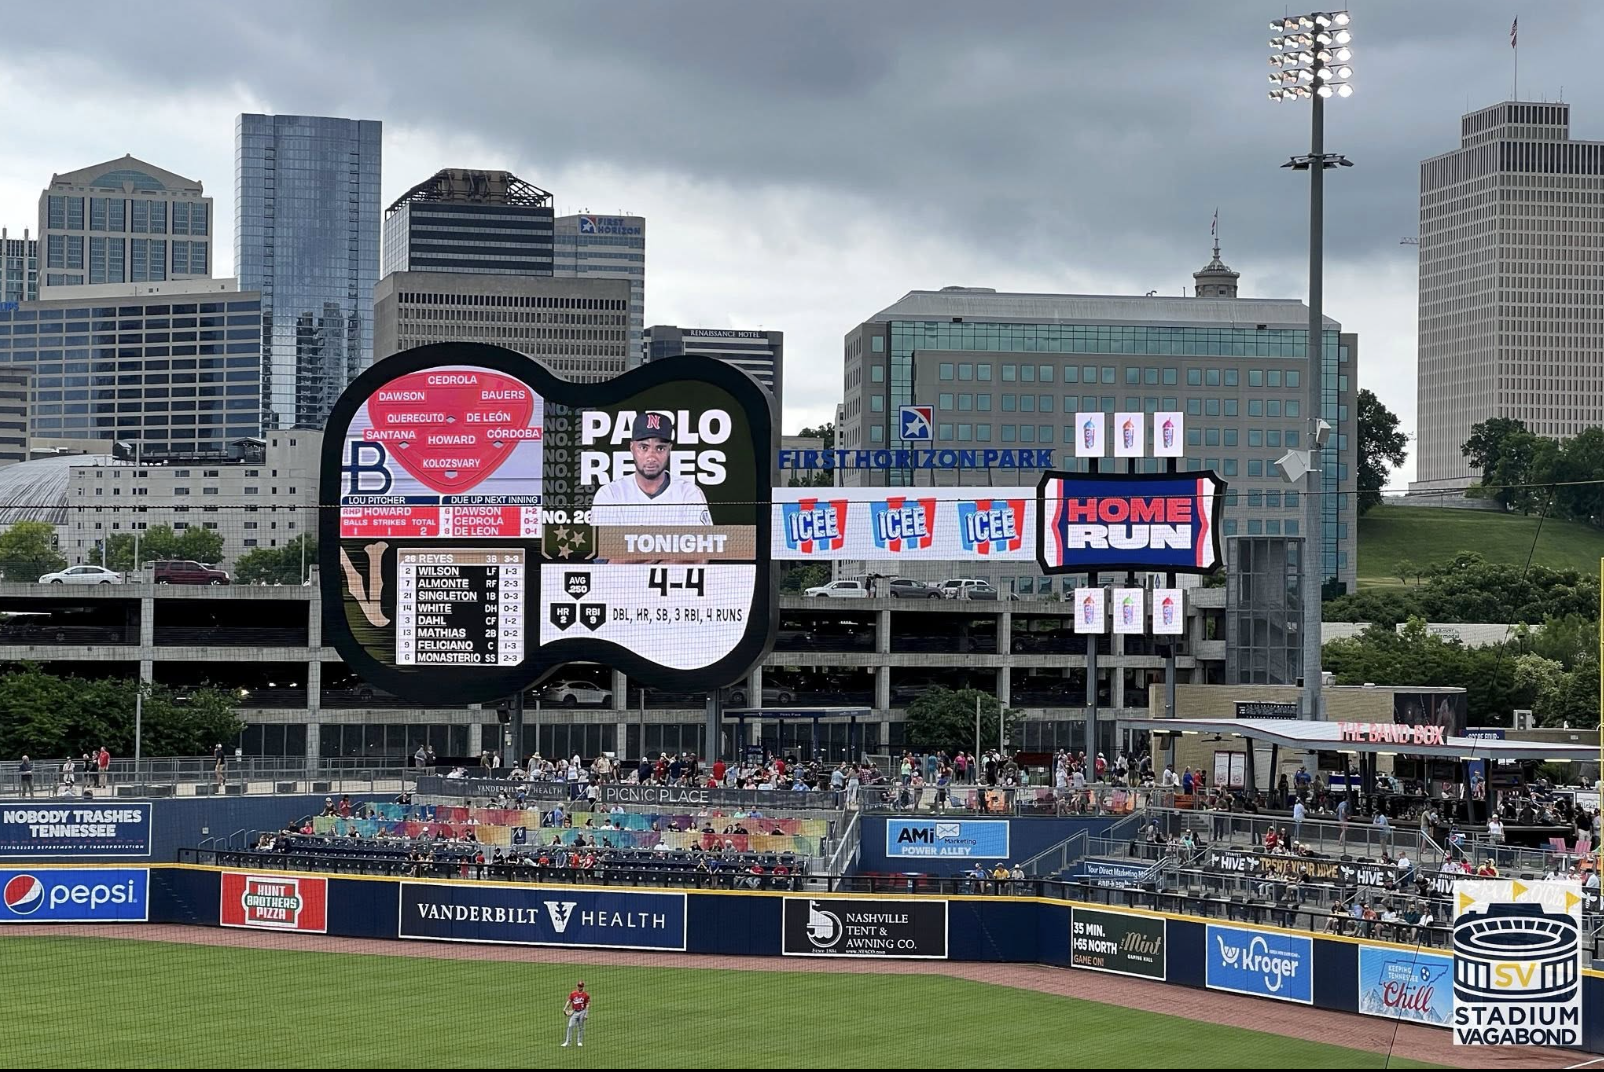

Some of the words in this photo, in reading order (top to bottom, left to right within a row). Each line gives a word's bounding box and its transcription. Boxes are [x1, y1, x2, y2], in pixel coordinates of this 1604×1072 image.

[428, 376, 477, 384] CEDROLA
[379, 392, 424, 400] DAWSON
[482, 390, 526, 400] BAUERS
[388, 414, 444, 423] QUERECUTO
[467, 414, 481, 422] DE
[484, 410, 510, 422] LEÓN
[366, 431, 416, 440] SANTANA
[487, 428, 539, 438] CÓRDOBA
[428, 436, 476, 444] HOWARD
[423, 459, 480, 468] KOLOZSVARY
[778, 450, 847, 469] FIRST
[856, 450, 977, 468] HORIZON
[983, 450, 1054, 468] PARK
[580, 450, 726, 486] REES
[364, 507, 411, 516] HOWARD
[454, 507, 501, 515] DAWSON
[1068, 498, 1192, 522] HOME
[454, 517, 504, 525] CEDROLA
[542, 510, 571, 524] NO.
[876, 506, 927, 540] ICEE
[790, 507, 838, 542] ICEE
[966, 508, 1016, 542] ICEE
[420, 527, 427, 535] 2
[1068, 525, 1192, 549] RUN
[625, 535, 727, 552] TONIGHT
[419, 555, 453, 563] REYES
[418, 567, 459, 575] WILSON
[418, 579, 469, 588] ALMONTE
[648, 568, 704, 596] 4-4
[568, 585, 587, 593] .250
[418, 592, 477, 600] SINGLETON
[418, 604, 452, 612] WHITE
[418, 616, 446, 624] DAHL
[613, 608, 633, 624] DBL,
[637, 608, 652, 624] HR,
[656, 608, 671, 624] SB,
[675, 608, 680, 621] 3
[685, 608, 702, 624] RBI,
[707, 608, 712, 621] 4
[717, 608, 742, 621] RUNS
[418, 628, 466, 637] MATHIAS
[418, 641, 473, 649] FELICIANO
[418, 653, 480, 662] MONASTERIO
[1338, 722, 1365, 742] THE
[1369, 723, 1410, 743] BAND
[1414, 725, 1445, 745] BOX
[607, 787, 655, 802] PICNIC
[660, 789, 709, 803] PLACE
[4, 810, 69, 823] NOBODY
[73, 809, 142, 823] TRASHES
[29, 825, 116, 837] TENNESSEE
[898, 828, 934, 844] AMi
[940, 847, 971, 855] ALLEY
[1221, 857, 1246, 870] HIVE
[1088, 865, 1098, 874] Your
[1099, 867, 1113, 875] Direct
[1114, 869, 1138, 879] Marketing
[1317, 864, 1338, 878] HIVE
[1357, 870, 1384, 885] HIVE
[50, 880, 134, 909] pepsi
[258, 885, 286, 896] HUNT
[247, 896, 296, 908] BROTHERS
[257, 907, 286, 919] PIZZA
[417, 903, 538, 924] VANDERBILT
[582, 911, 665, 929] HEALTH
[846, 913, 908, 924] NASHVILLE
[846, 926, 876, 935] TENT
[880, 927, 887, 936] &
[1074, 922, 1084, 934] 35
[1086, 924, 1105, 937] MIN.
[846, 939, 894, 948] AWNING
[898, 940, 917, 949] CO.
[1074, 938, 1087, 950] I-65
[1088, 940, 1117, 954] NORTH
[1124, 932, 1161, 955] Mint
[1074, 955, 1092, 965] GAME
[1242, 936, 1299, 992] Kroger
[1388, 965, 1412, 974] KEEPING
[1384, 981, 1434, 1013] Chill
